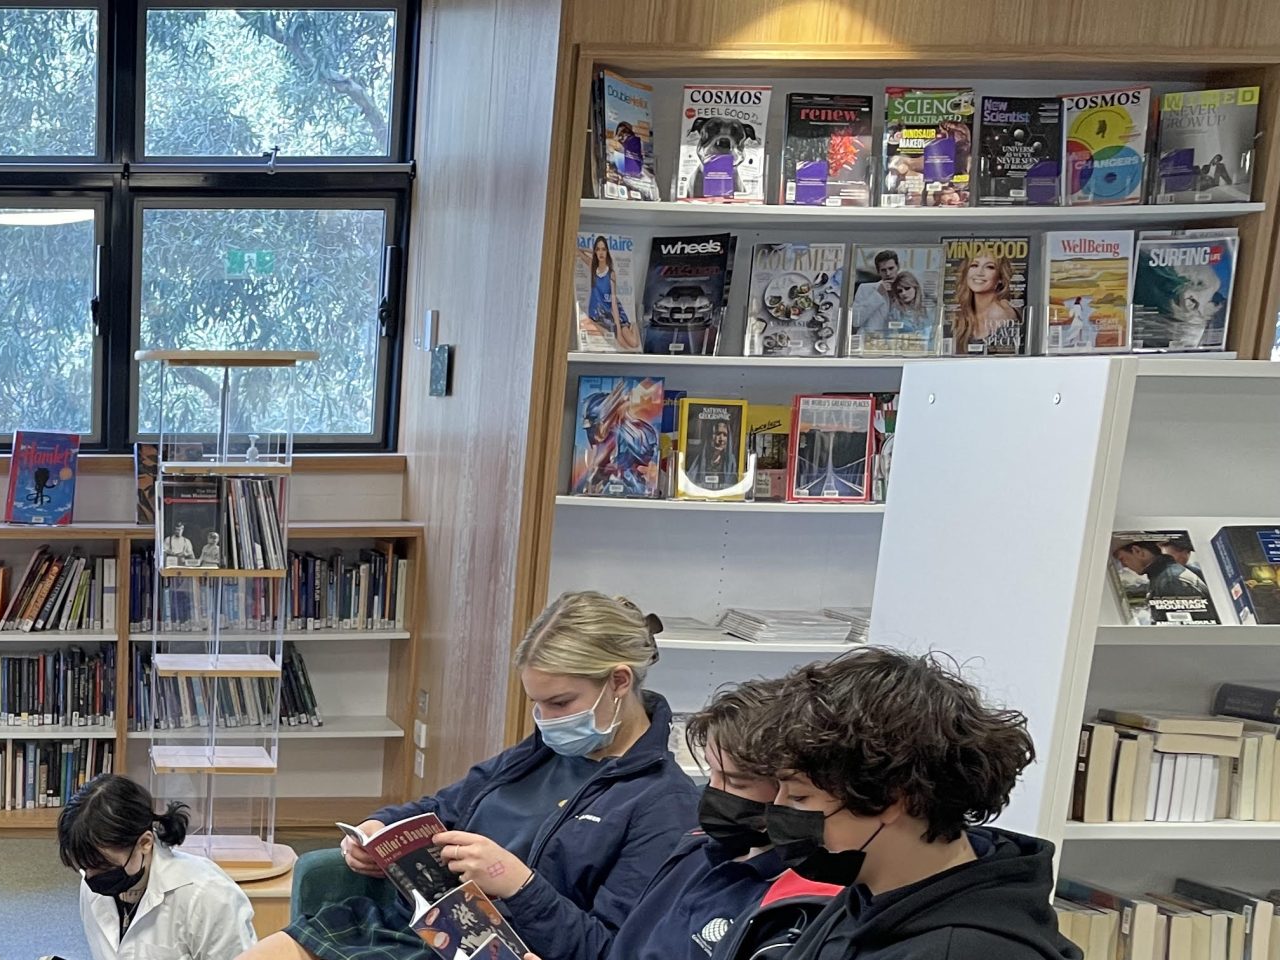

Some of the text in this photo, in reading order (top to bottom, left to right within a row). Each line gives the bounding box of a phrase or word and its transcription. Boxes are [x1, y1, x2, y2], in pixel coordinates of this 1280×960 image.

[690, 90, 762, 105] COSMOS
[984, 98, 1008, 111] New
[1066, 90, 1141, 111] COSMOS
[697, 107, 723, 117] FEEL
[724, 107, 751, 121] GOOD
[894, 99, 971, 115] SCIENCE
[983, 110, 1031, 124] Scientist
[902, 128, 936, 139] DINOSAUR
[1061, 238, 1120, 257] WellBeing
[1148, 246, 1211, 267] SURFING
[698, 412, 732, 420] GEOGRAPHIC
[804, 409, 861, 428] TIME
[1148, 598, 1209, 606] BROKEBACK
